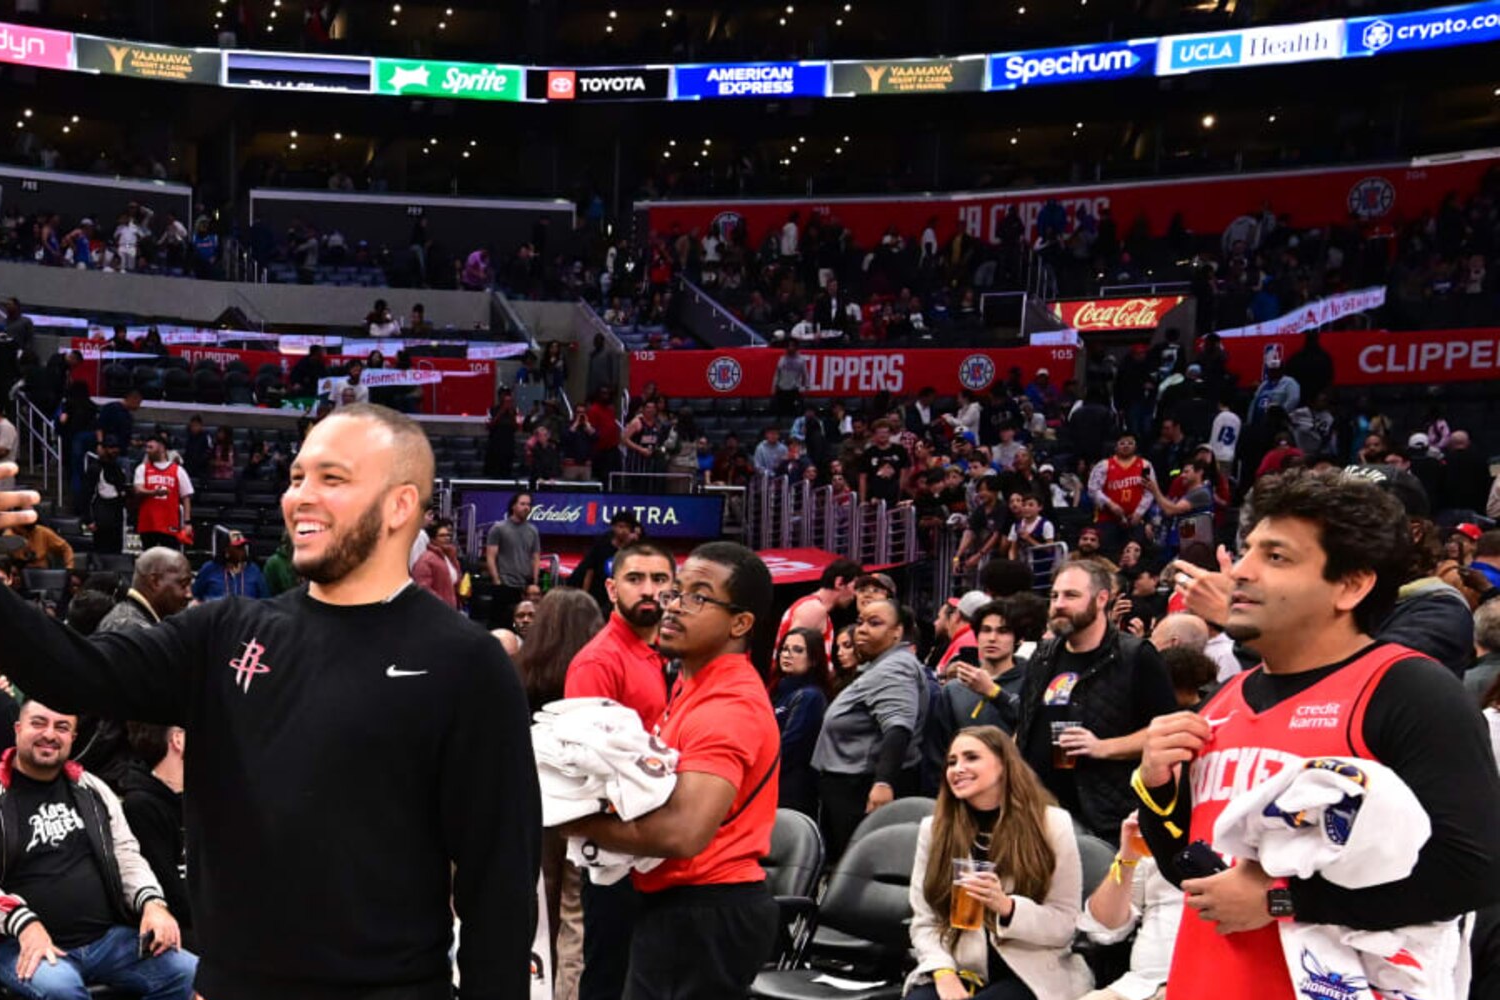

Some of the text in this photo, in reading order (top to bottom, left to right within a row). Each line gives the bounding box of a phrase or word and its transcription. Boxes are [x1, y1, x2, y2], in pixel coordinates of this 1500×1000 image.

[1179, 32, 1328, 62] UCLA Health
[707, 66, 794, 83] AMERICAN
[1005, 49, 1132, 84] Spectrum
[442, 67, 507, 95] Sprite
[580, 76, 646, 92] TOYOTA
[718, 80, 794, 96] EXPRESS
[633, 350, 656, 361] 105
[1050, 349, 1074, 361] 105
[468, 362, 490, 374] 104
[1296, 702, 1341, 716] credit
[1288, 716, 1339, 729] karma
